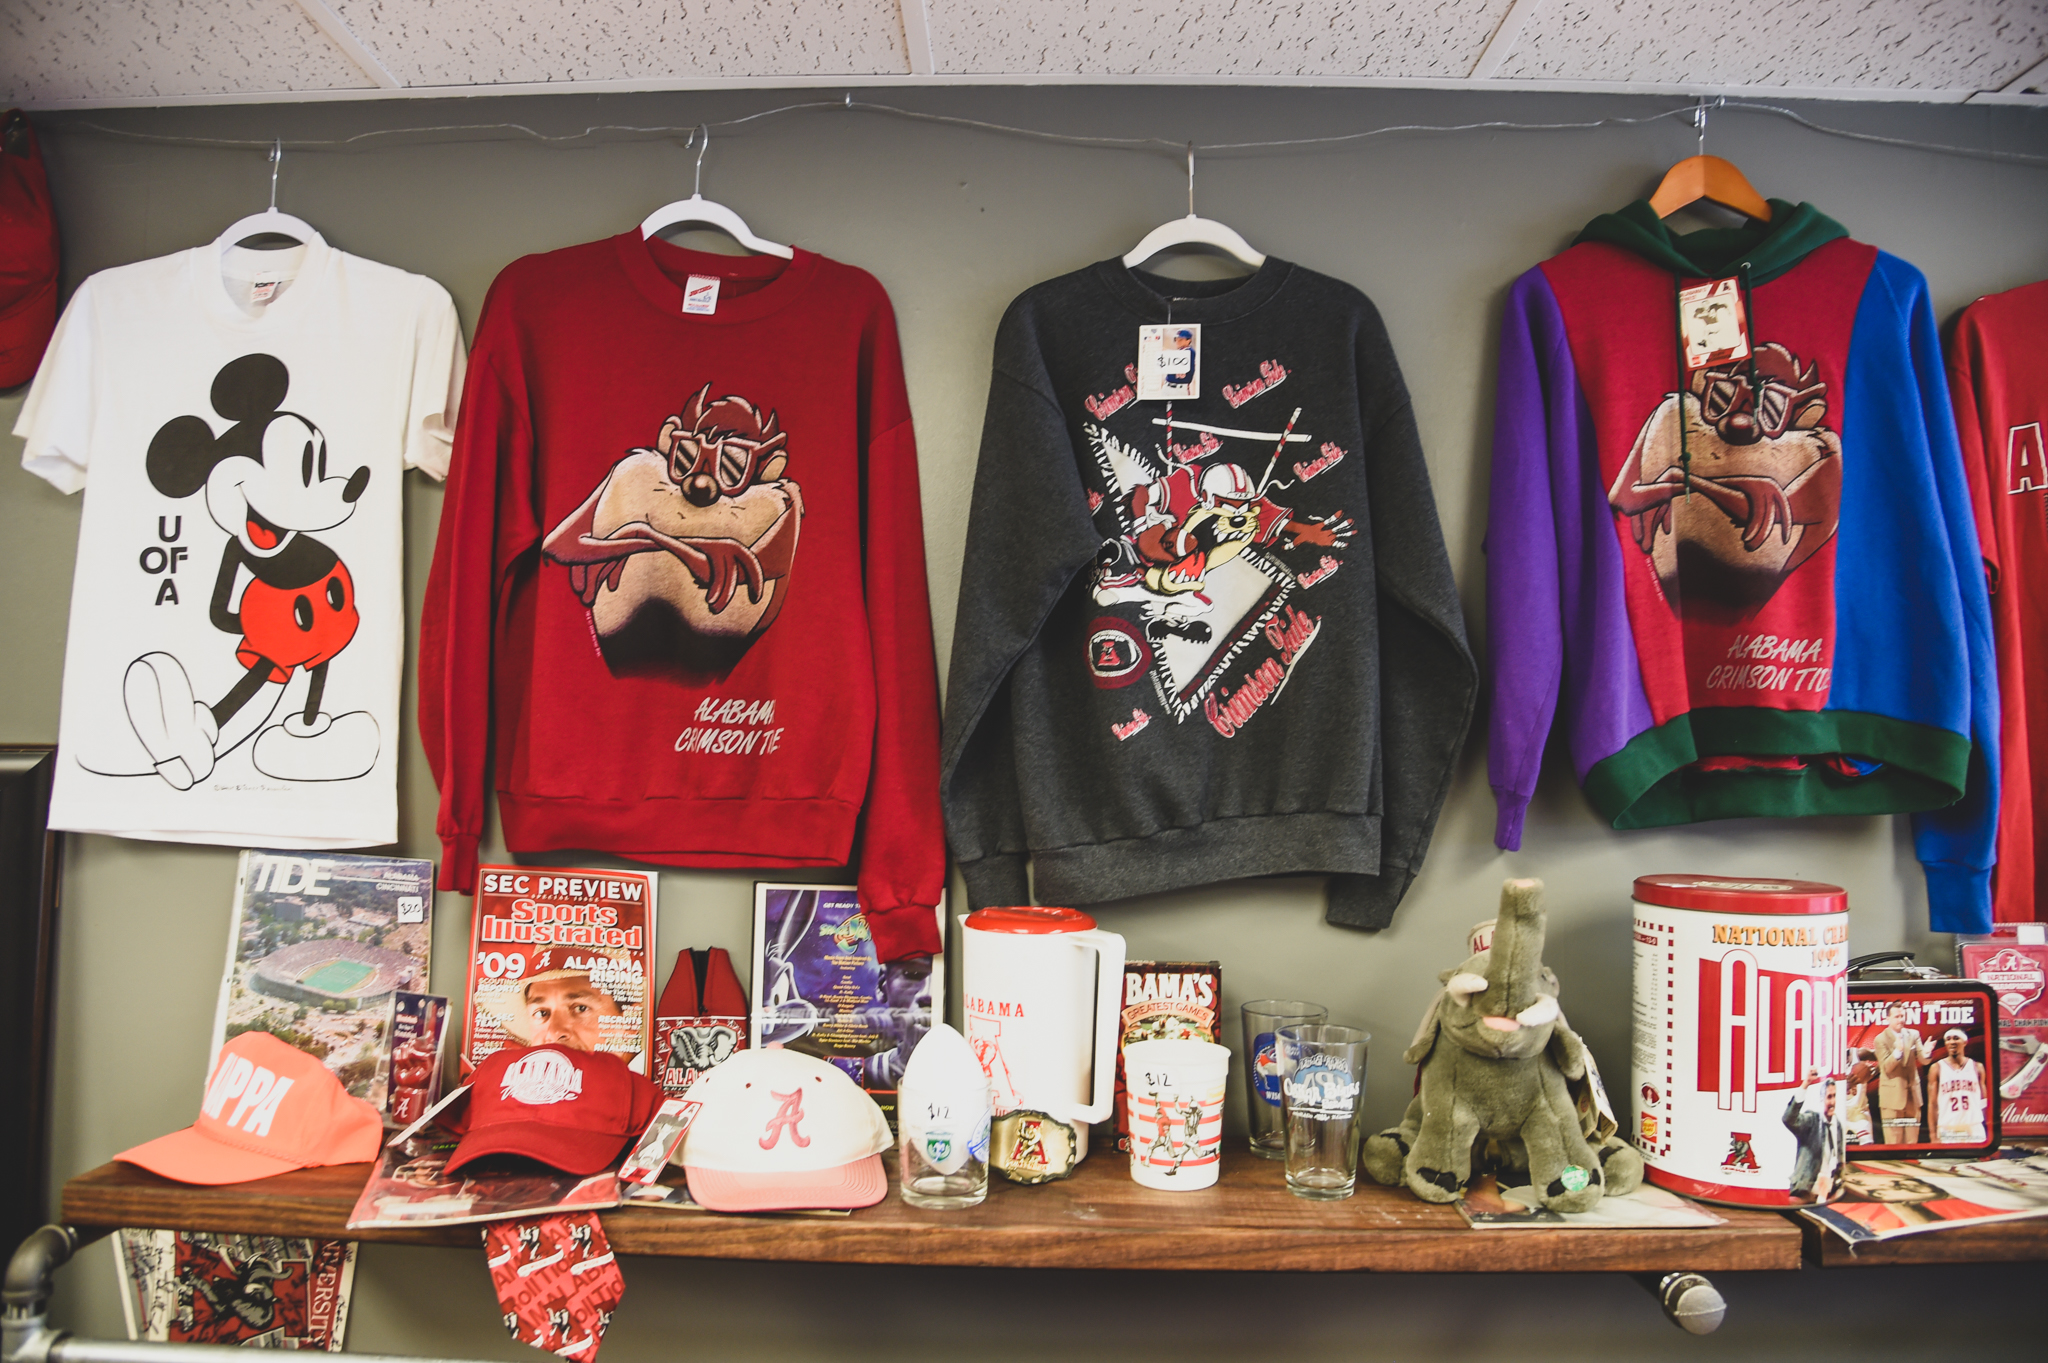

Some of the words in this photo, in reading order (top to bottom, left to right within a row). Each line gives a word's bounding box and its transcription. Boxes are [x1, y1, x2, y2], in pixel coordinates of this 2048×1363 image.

[1157, 354, 1189, 368] $100
[2006, 421, 2048, 494] A
[158, 515, 182, 543] U
[139, 546, 188, 574] OF
[155, 578, 179, 606] A
[1727, 634, 1824, 663] ALABAMA
[1706, 664, 1794, 691] CRIMSON
[1204, 657, 1285, 738] Crimson
[253, 855, 335, 896] TIDE
[484, 874, 530, 893] SEC
[539, 877, 643, 901] PREVIEW
[511, 898, 618, 927] Sports
[481, 915, 643, 949] Illustrated
[1712, 924, 1818, 946] NATIONAL
[563, 956, 643, 973] ALABAMA
[1811, 947, 1839, 968] 1992
[589, 970, 643, 985] RISING
[1125, 972, 1213, 1007] BAMA'S
[1987, 973, 2036, 981] NATIONAL
[963, 992, 1024, 1017] LABAMA
[1127, 1001, 1174, 1020] GREATEST
[1176, 1002, 1209, 1021] GAMES
[1923, 1005, 1974, 1025] TIDE
[663, 1067, 702, 1087] ALA
[1951, 1096, 1969, 1111] 25
[759, 1087, 811, 1150] A
